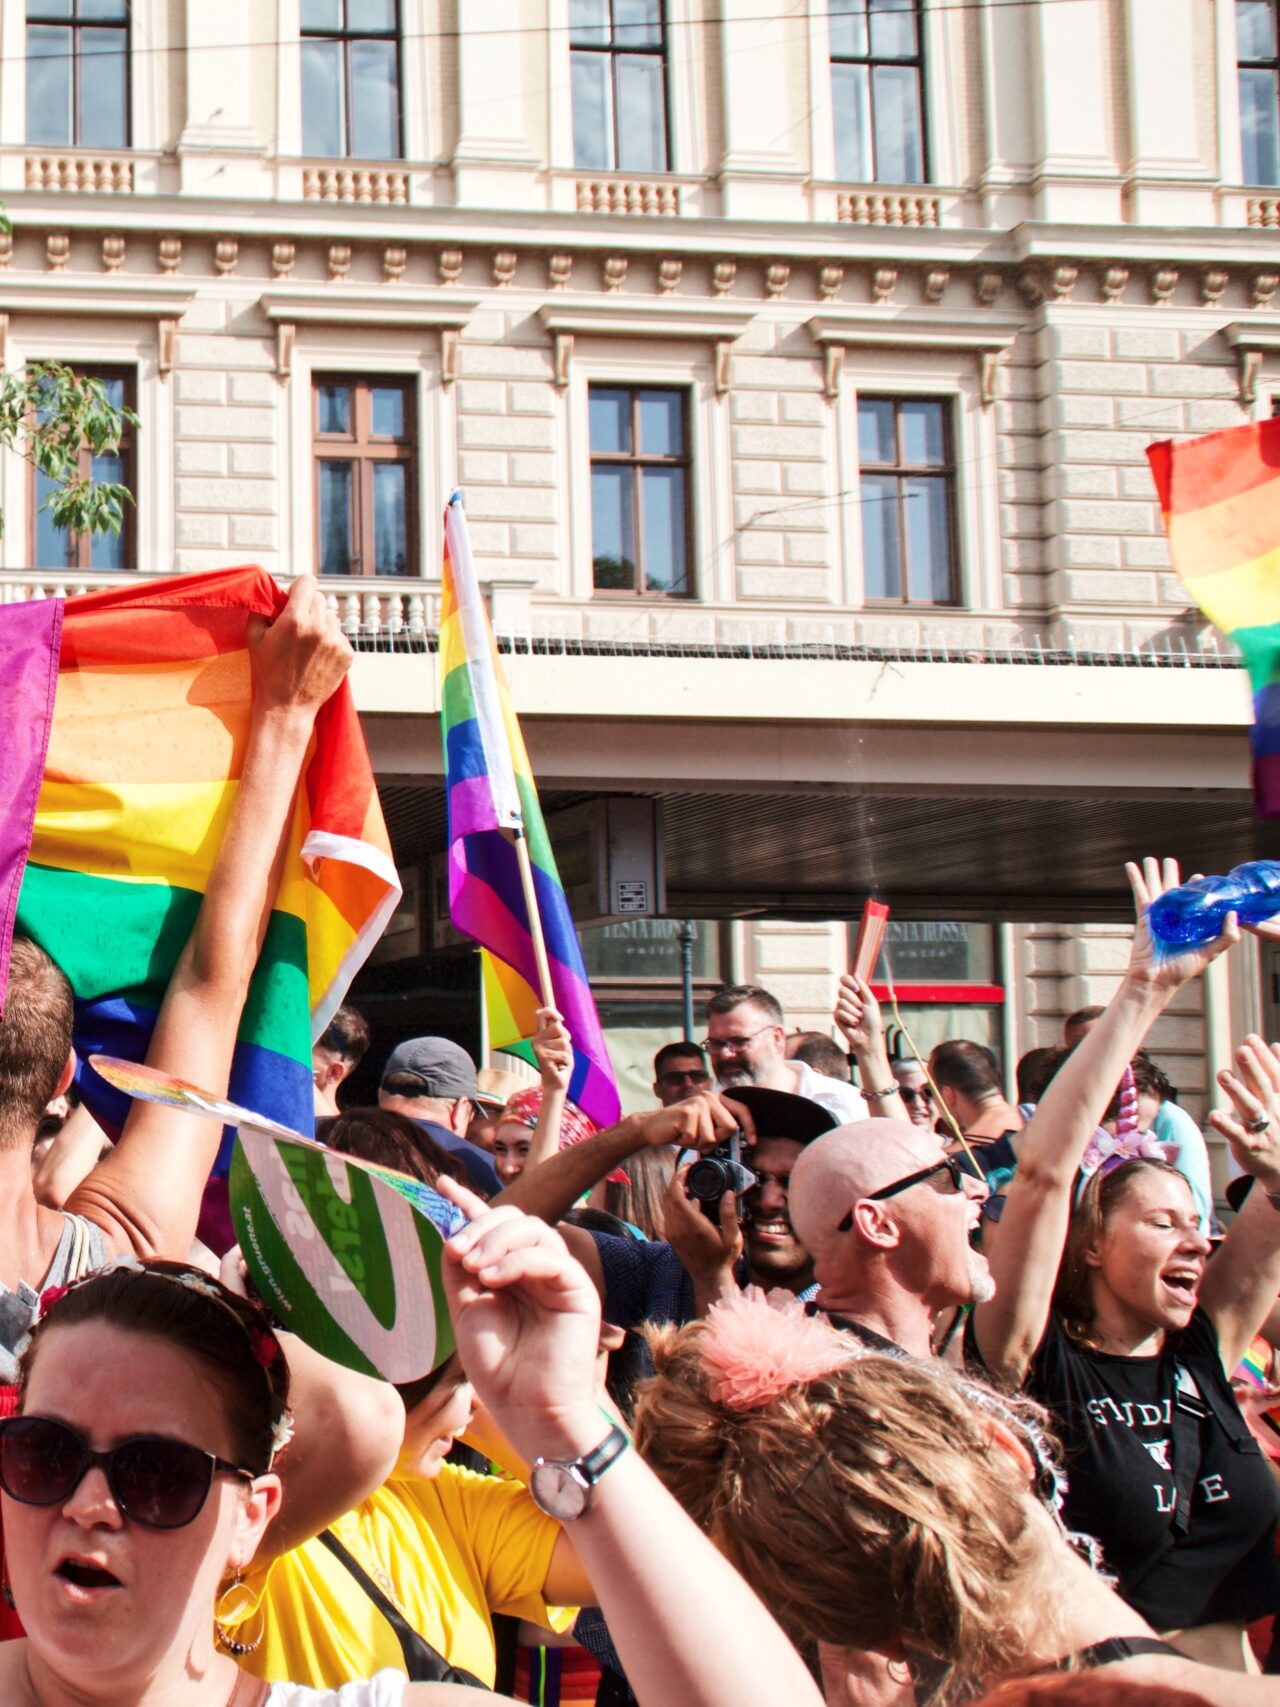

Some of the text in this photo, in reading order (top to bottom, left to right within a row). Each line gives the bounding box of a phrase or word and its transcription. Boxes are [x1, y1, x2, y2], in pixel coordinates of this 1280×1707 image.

[652, 919, 698, 939] ROSA
[883, 922, 969, 942] ESTA ROSSA
[242, 1206, 293, 1312] wien.gruene.at
[1152, 1473, 1231, 1513] LE
